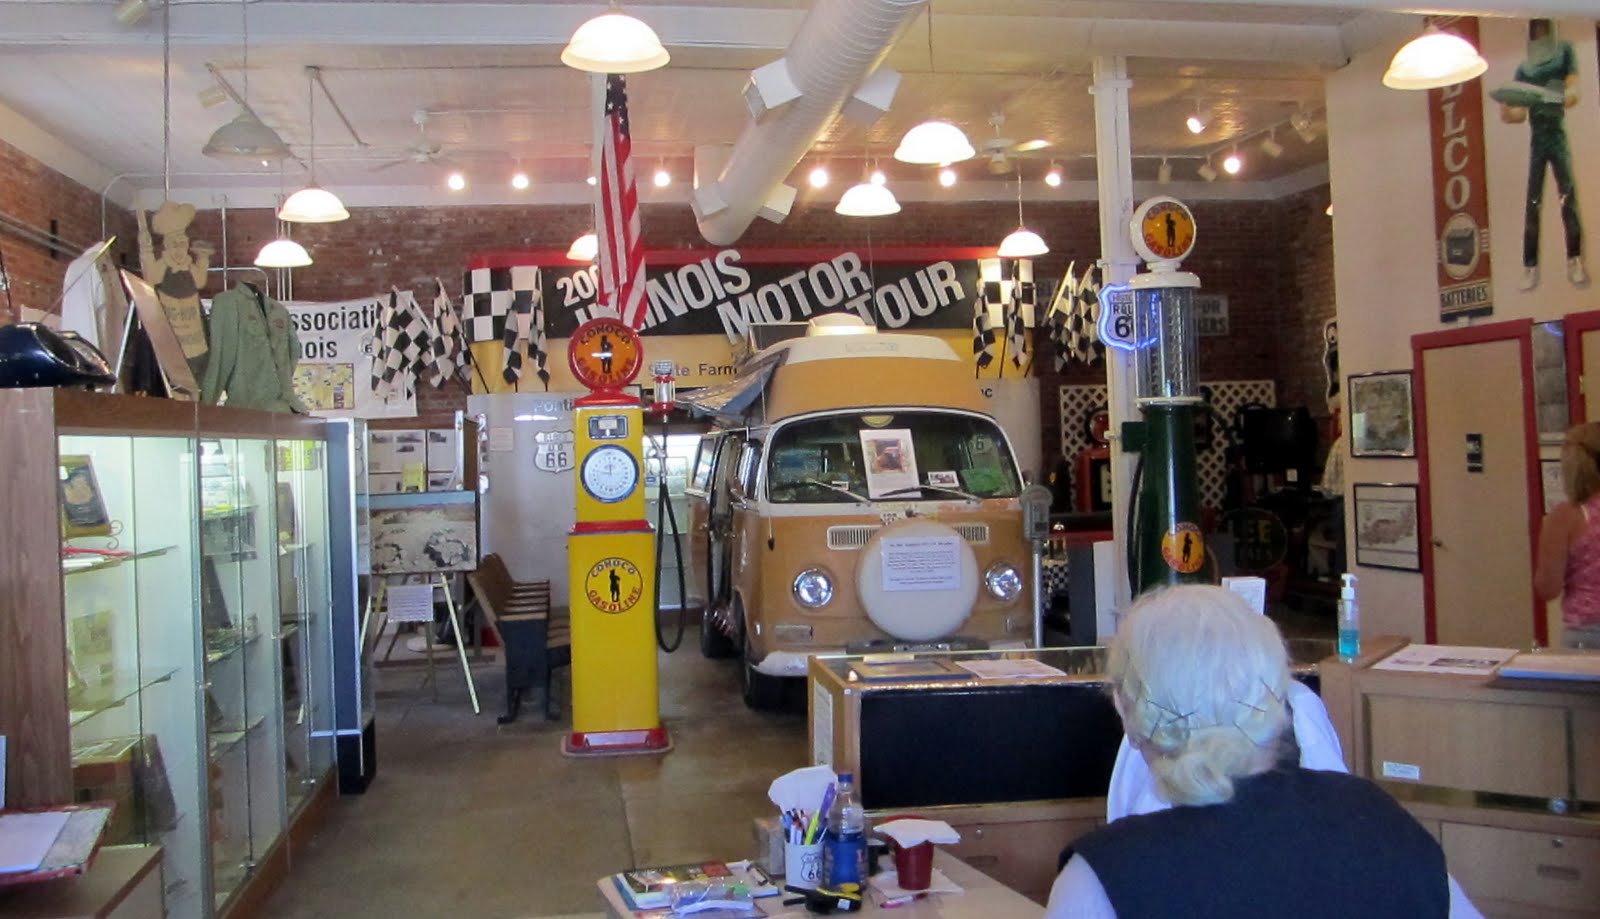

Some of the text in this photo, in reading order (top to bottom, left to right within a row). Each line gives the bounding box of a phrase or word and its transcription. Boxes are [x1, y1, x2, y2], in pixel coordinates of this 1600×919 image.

[556, 265, 600, 308] 200
[574, 249, 751, 333] INOIS
[716, 252, 873, 346] MOTOR
[846, 261, 966, 329] TOUR
[1440, 286, 1488, 307] BATTERIES
[290, 304, 375, 332] ssociati
[580, 323, 631, 345] CONOCO
[545, 451, 568, 468] 66
[591, 560, 636, 578] CONOCO
[590, 586, 641, 613] GASOLINE
